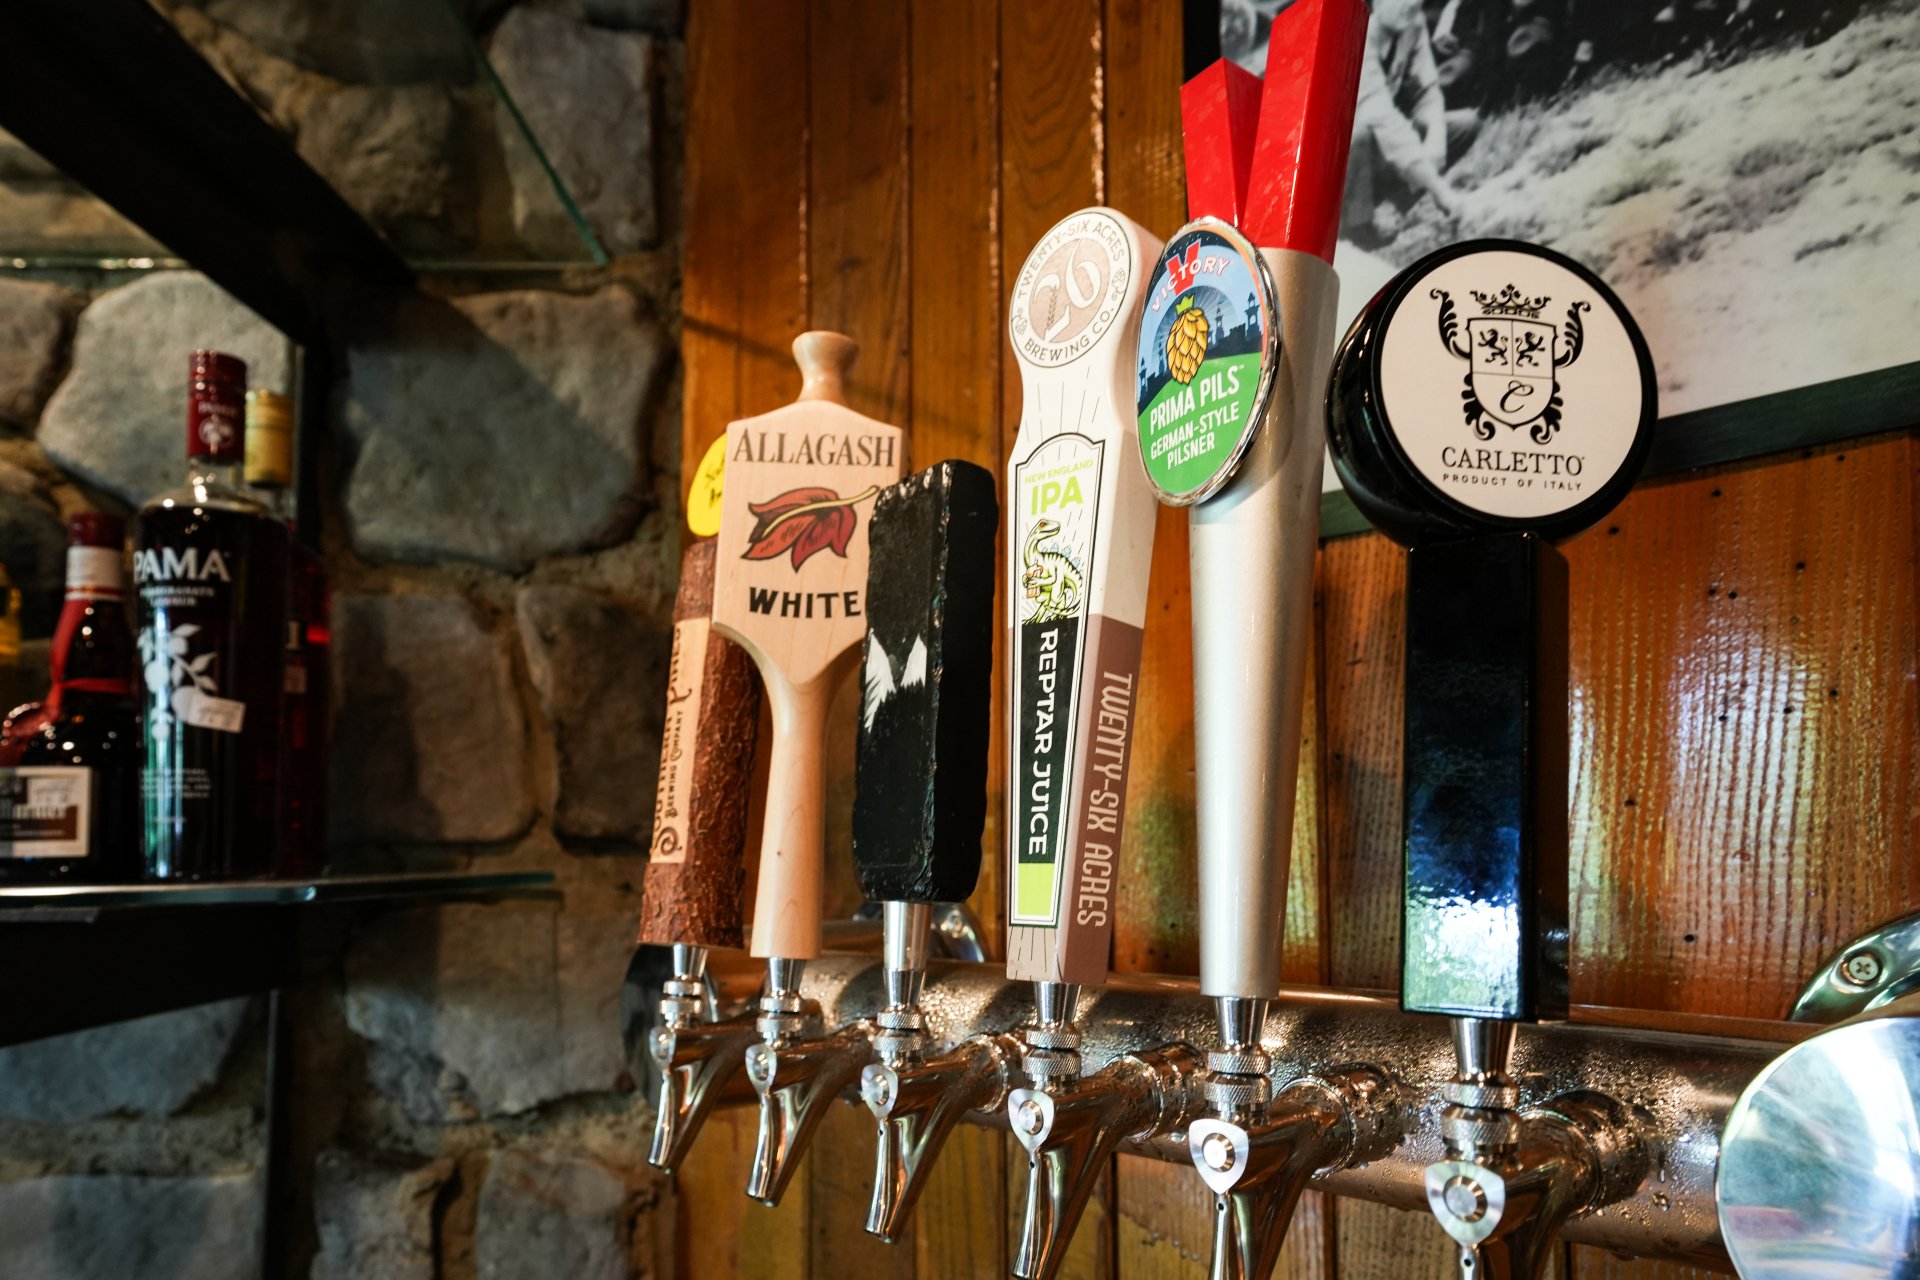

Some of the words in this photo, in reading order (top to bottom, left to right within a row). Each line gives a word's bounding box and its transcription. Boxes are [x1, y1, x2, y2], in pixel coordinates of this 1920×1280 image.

[1018, 219, 1091, 298] TWENTY-SIX
[1092, 222, 1124, 262] ACRES
[1152, 255, 1231, 312] VICTORY
[1024, 334, 1090, 361] BREWING
[1093, 308, 1115, 334] CO.
[1150, 385, 1195, 435] PRIMA
[1200, 365, 1240, 407] PILS
[733, 428, 896, 467] ALLAGASH
[1150, 401, 1240, 460] GERMAN-STYLE
[1167, 432, 1215, 470] PILSNER
[1024, 471, 1047, 484] NEW
[1047, 459, 1094, 478] ENGLAND
[1442, 446, 1583, 476] CARLETTO
[1443, 473, 1507, 486] PRODUCT
[1517, 479, 1534, 488] OF
[1544, 480, 1582, 491] ITALY
[1031, 476, 1084, 516] IPA
[133, 547, 231, 584] PAMA
[749, 586, 861, 619] WHITE
[1034, 627, 1059, 755] REPTAR
[1086, 671, 1133, 834] TWENTY-SIX
[1028, 761, 1053, 855] JUICE
[1077, 842, 1114, 927] ACRES
